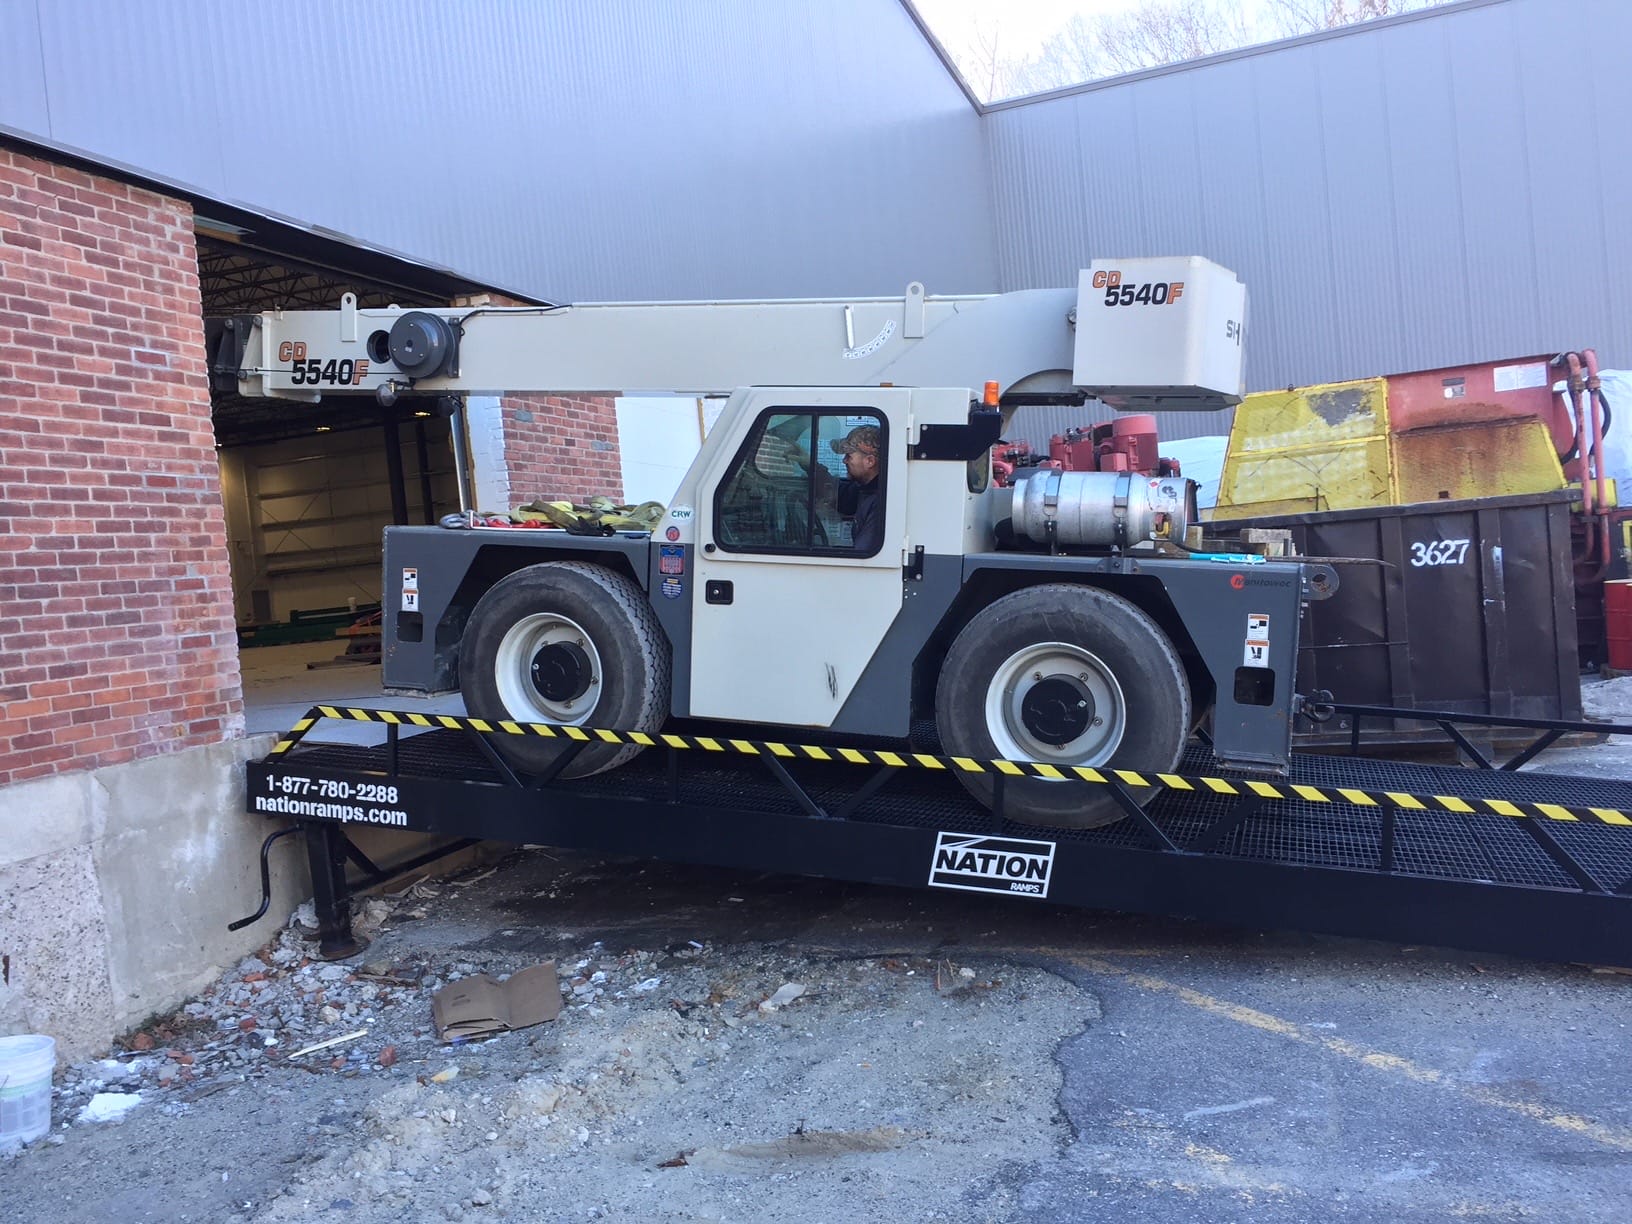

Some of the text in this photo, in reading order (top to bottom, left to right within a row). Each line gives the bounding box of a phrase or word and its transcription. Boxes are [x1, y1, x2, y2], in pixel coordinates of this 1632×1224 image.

[1092, 271, 1121, 288] CD
[1104, 282, 1184, 306] 5540F
[278, 341, 307, 361] CD
[291, 358, 369, 385] 5540F
[671, 510, 692, 518] CRW
[1410, 539, 1470, 567] 3627
[266, 774, 399, 804] 1-877-780-2288
[255, 796, 408, 826] nationramps.com
[935, 849, 1049, 881] NATION
[1010, 882, 1040, 893] RAMPS
